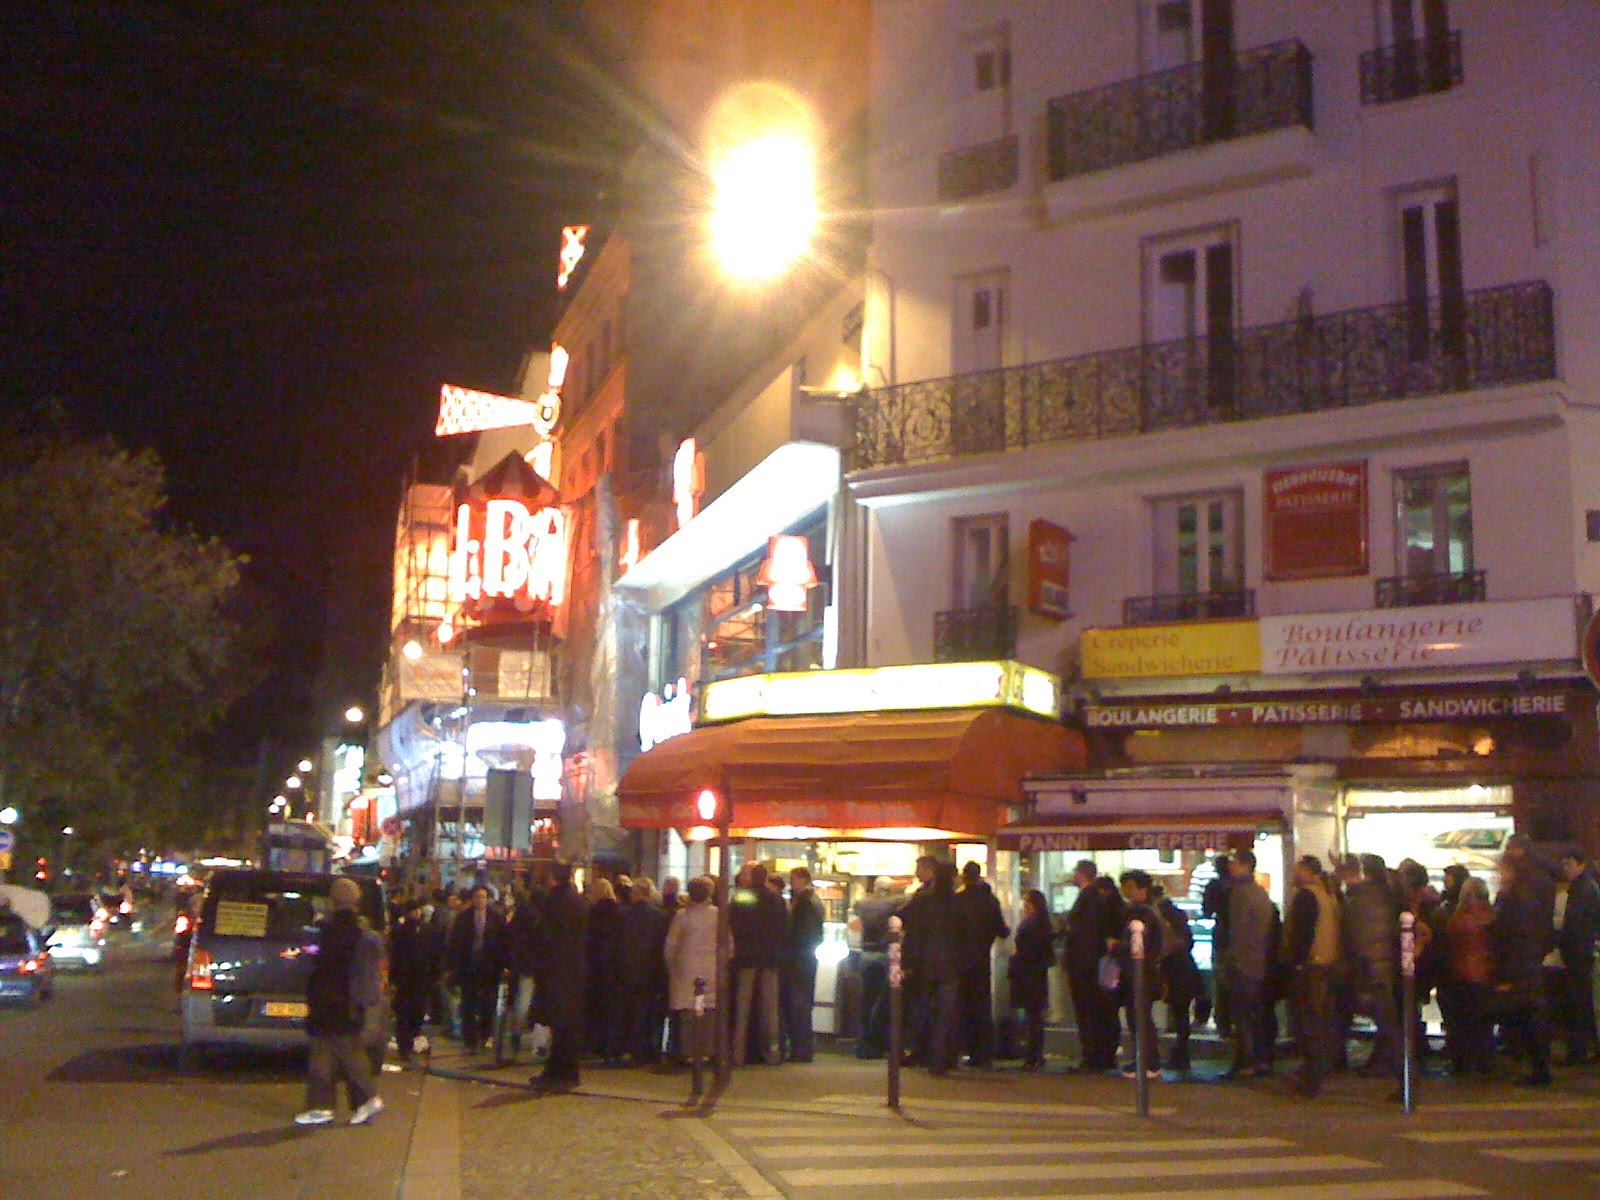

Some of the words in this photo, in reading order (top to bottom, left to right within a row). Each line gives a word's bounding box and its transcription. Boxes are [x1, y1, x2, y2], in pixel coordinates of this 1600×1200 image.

[1281, 615, 1483, 644] Boulangerie
[1087, 705, 1218, 726] BOULANGERIE
[1251, 703, 1362, 723] PATISSERIE
[1399, 695, 1566, 719] SANDWICHERIE
[1019, 834, 1089, 851] PANINI
[1128, 833, 1229, 850] CREPERIE
